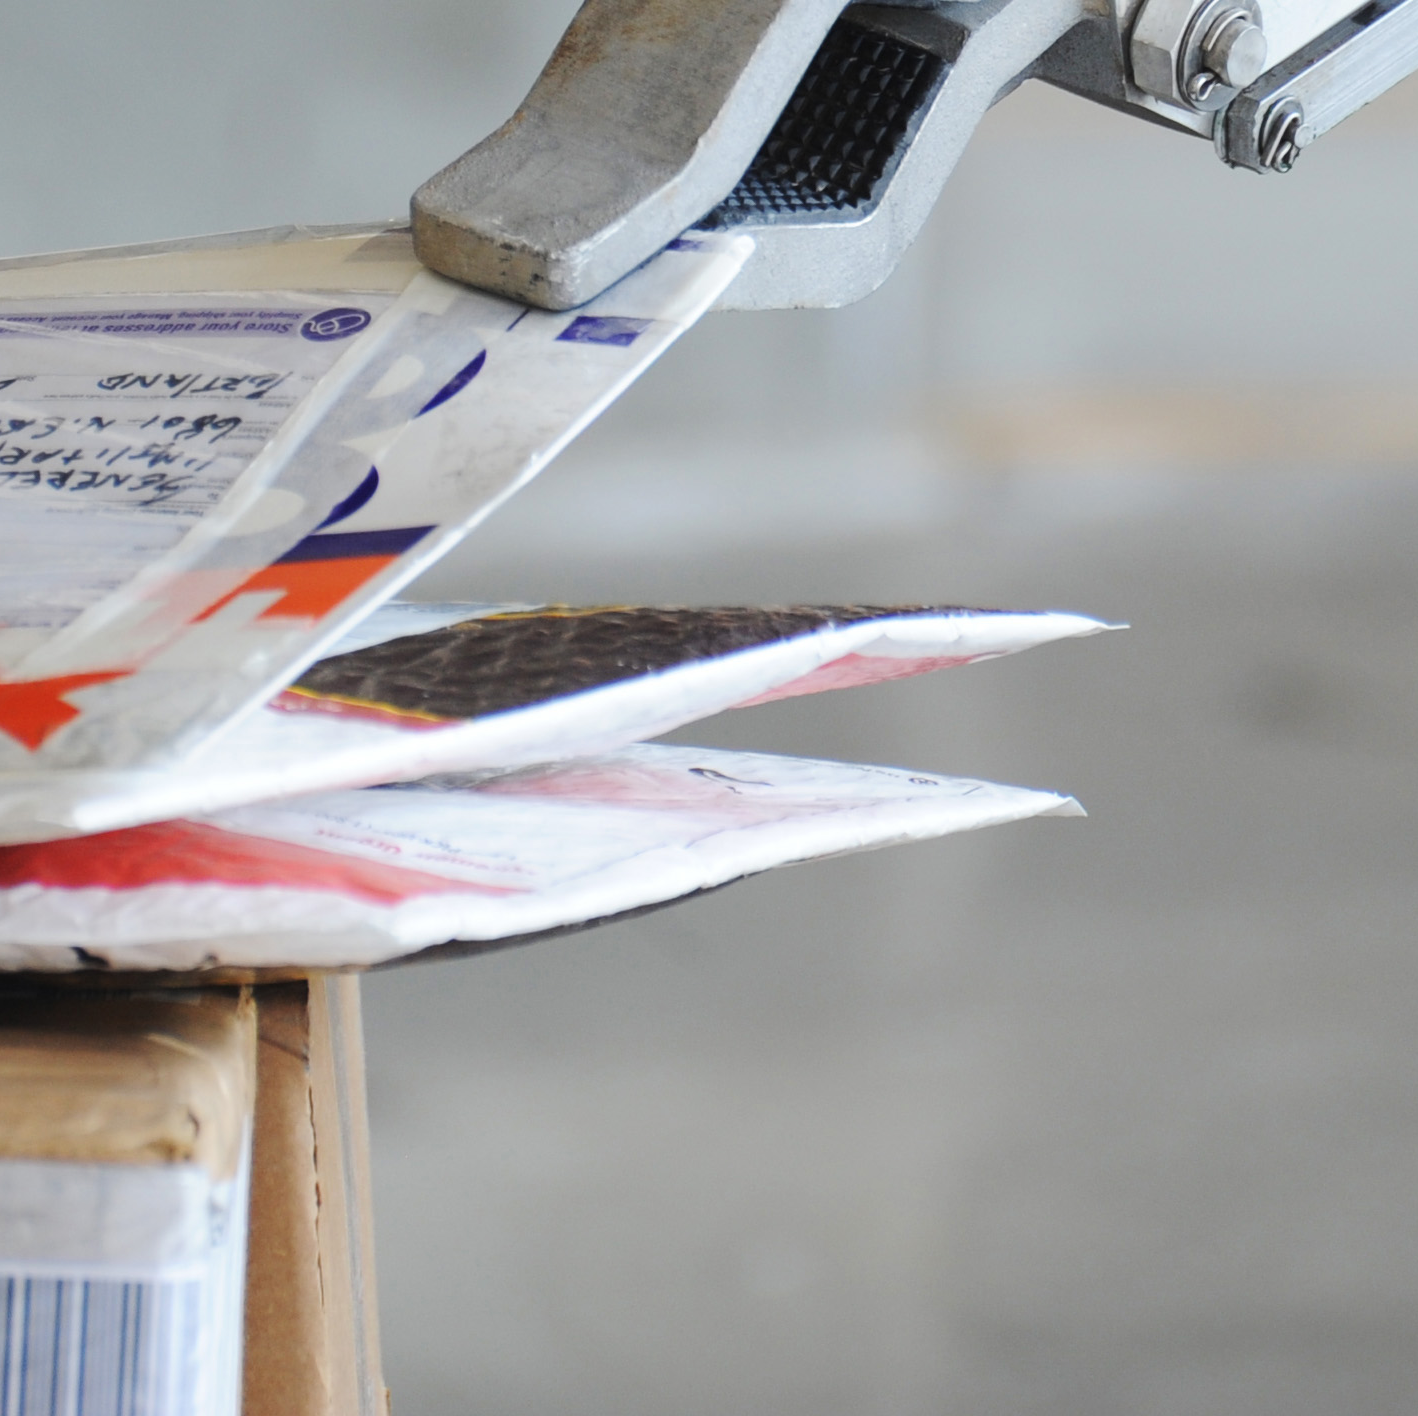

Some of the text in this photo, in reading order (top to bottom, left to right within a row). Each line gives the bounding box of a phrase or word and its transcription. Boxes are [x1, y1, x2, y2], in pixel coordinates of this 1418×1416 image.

[102, 324, 196, 335] addresses
[198, 320, 243, 332] your
[244, 323, 294, 334] Store
